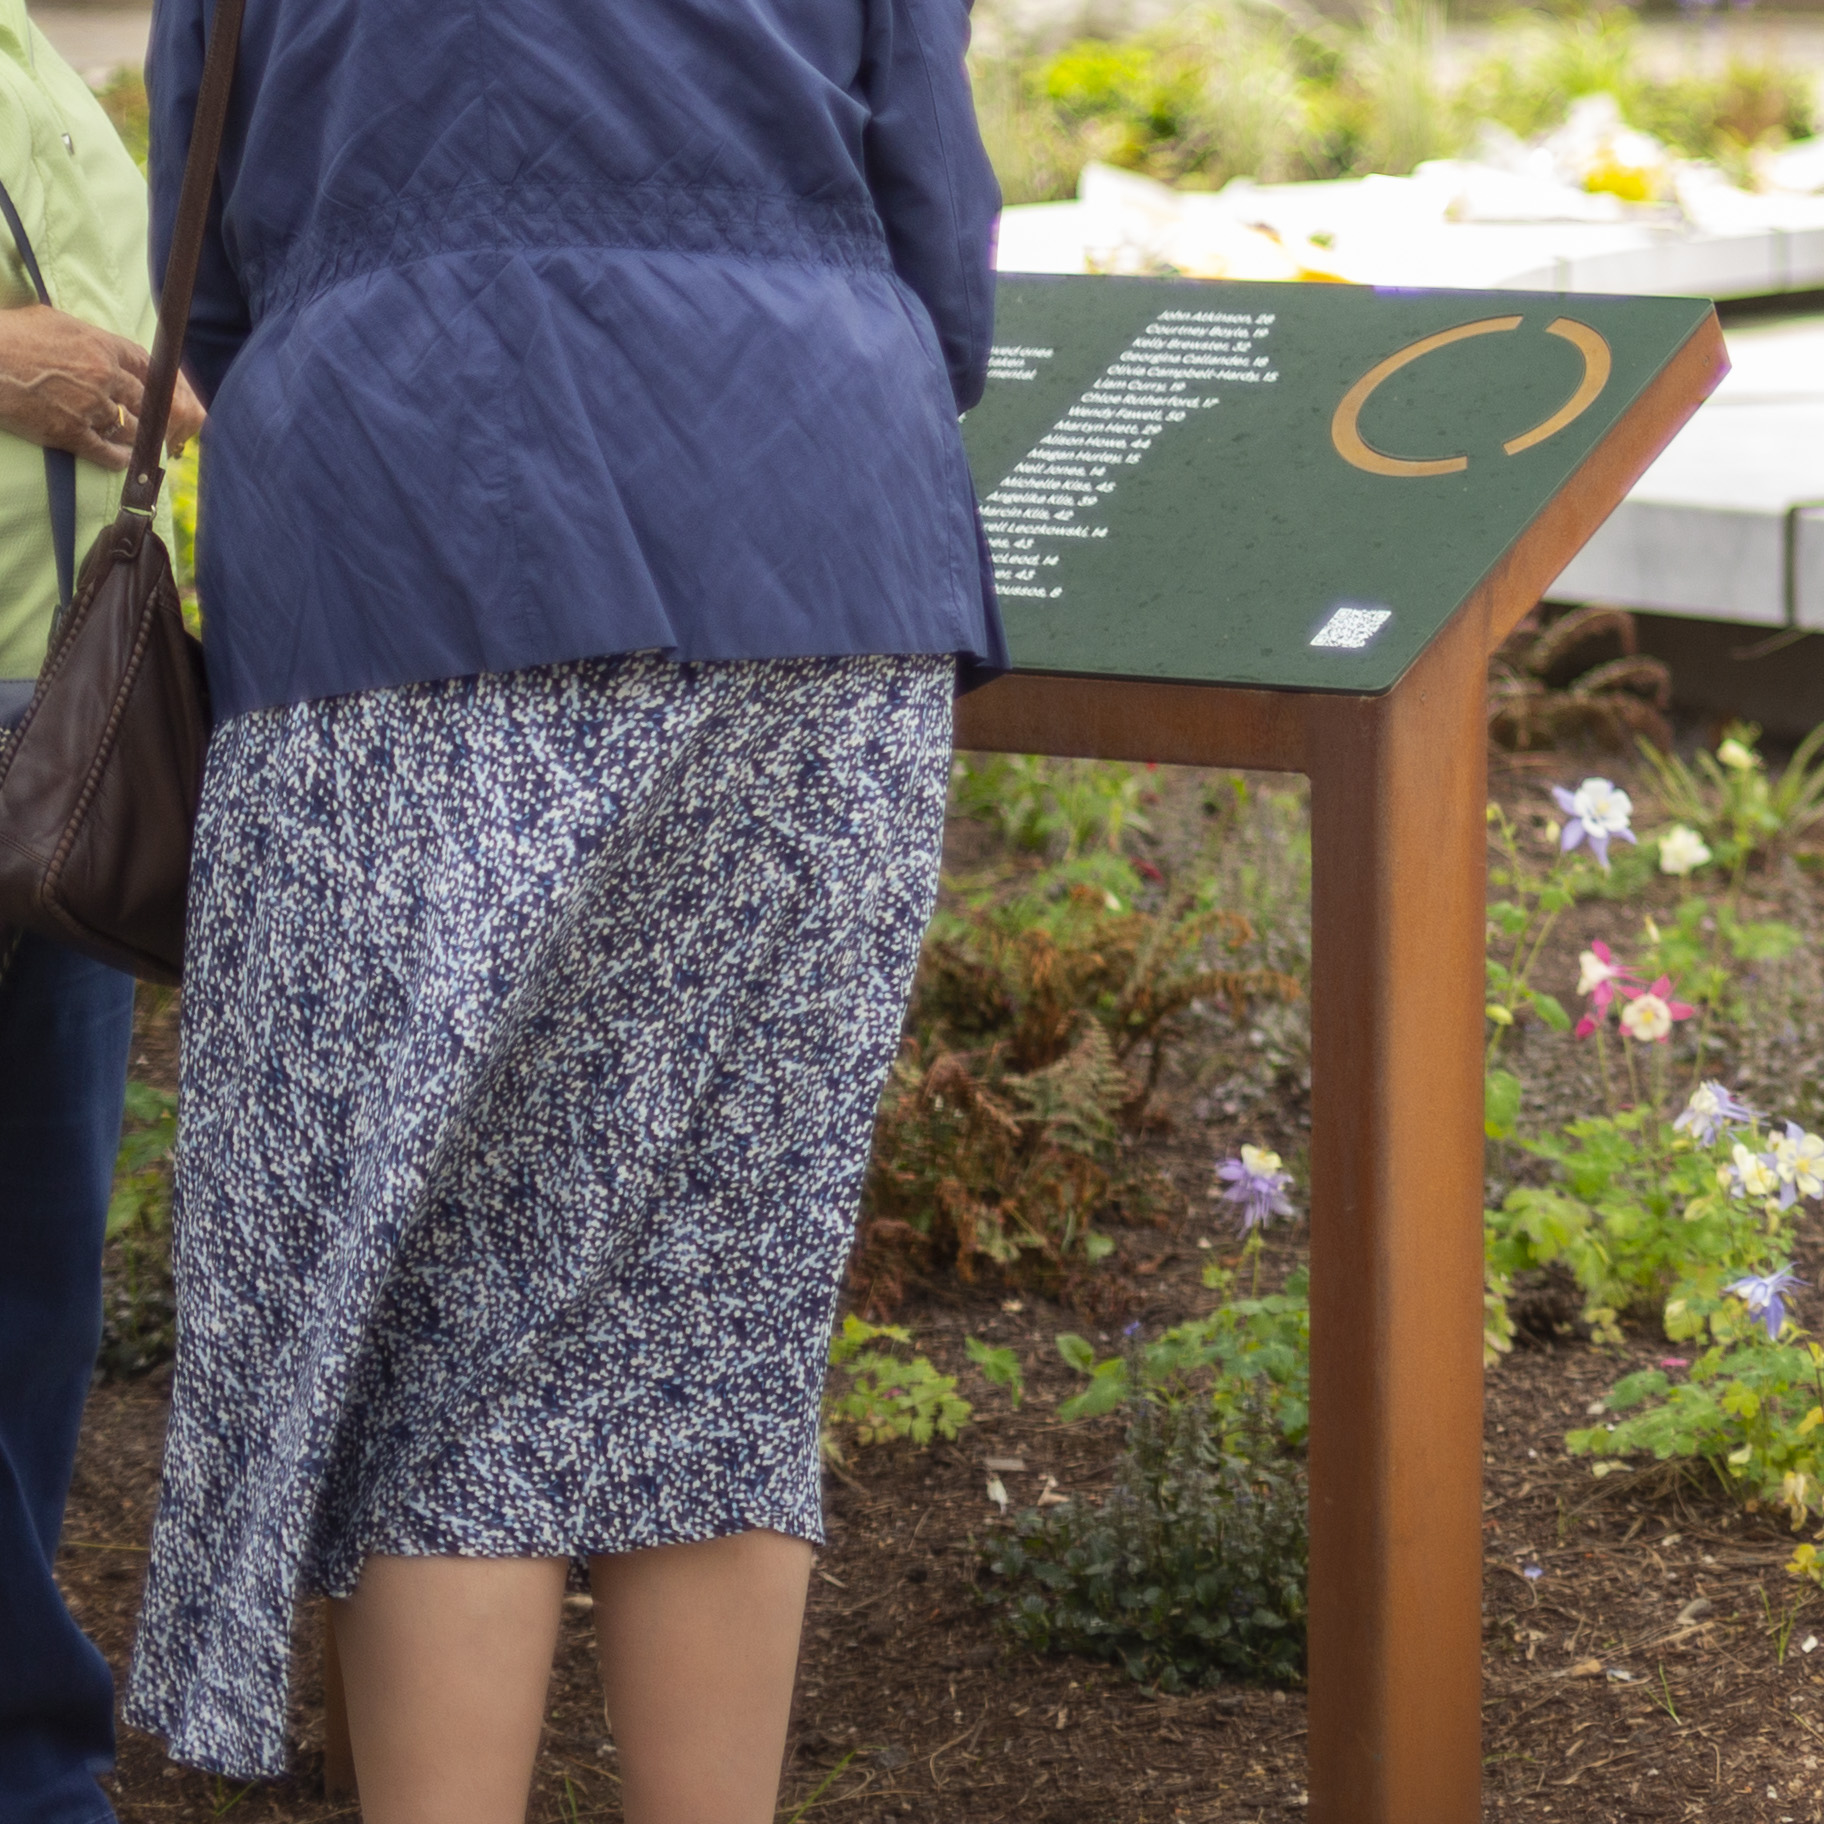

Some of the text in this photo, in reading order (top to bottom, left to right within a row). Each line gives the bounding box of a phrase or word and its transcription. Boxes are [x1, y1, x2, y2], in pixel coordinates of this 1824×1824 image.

[1157, 310, 1192, 322] John
[1145, 324, 1209, 337] Courtney
[1132, 337, 1168, 350] Kelly
[1120, 350, 1182, 364] Georgina
[1106, 364, 1147, 376] Olivia
[1093, 378, 1128, 390] Liam
[1080, 391, 1123, 404] Chloe
[1068, 405, 1116, 420] Wendy
[1053, 420, 1106, 434] Martyn
[1039, 434, 1086, 447] Alison
[1026, 448, 1076, 462] Megan
[1013, 462, 1046, 474] Nell
[1000, 476, 1062, 490] Michelle
[986, 490, 1048, 505] Angelika
[995, 583, 1047, 598] oussos,
